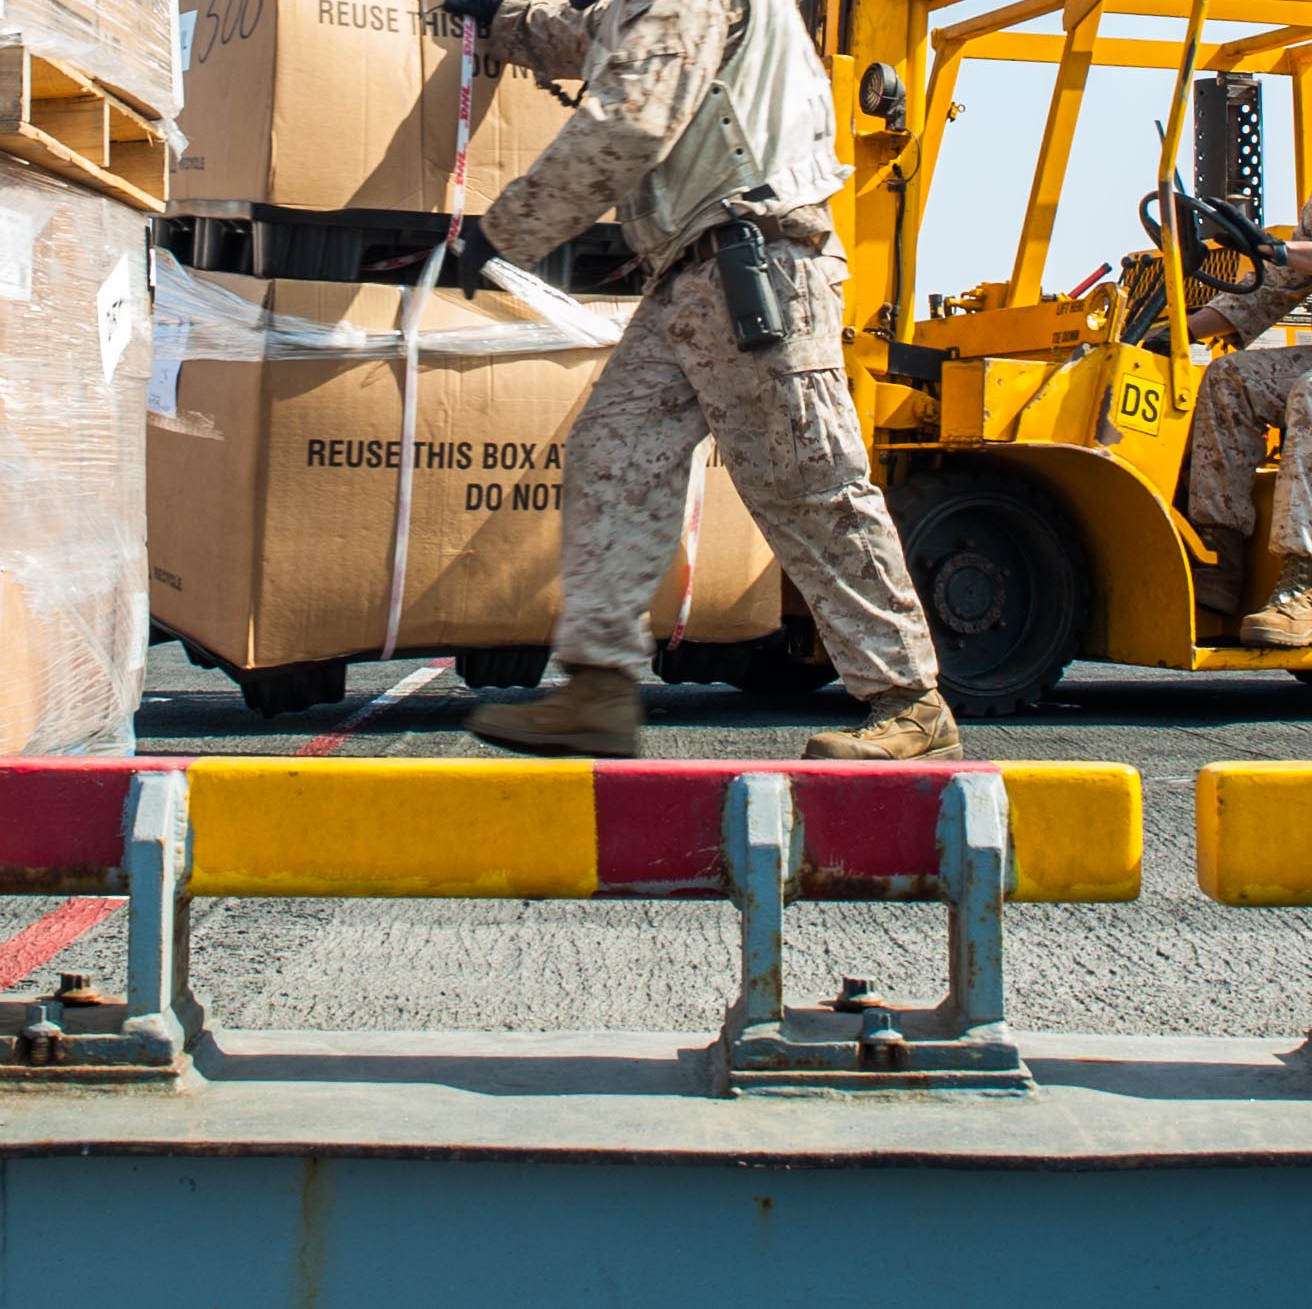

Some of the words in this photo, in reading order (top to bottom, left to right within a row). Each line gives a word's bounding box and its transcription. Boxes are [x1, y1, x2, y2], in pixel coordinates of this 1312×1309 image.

[407, 10, 465, 39] THIS
[1120, 382, 1160, 423] DS
[307, 439, 402, 468] REUSE
[413, 441, 473, 470] THIS
[481, 442, 536, 471] BOX
[465, 483, 502, 511] DO
